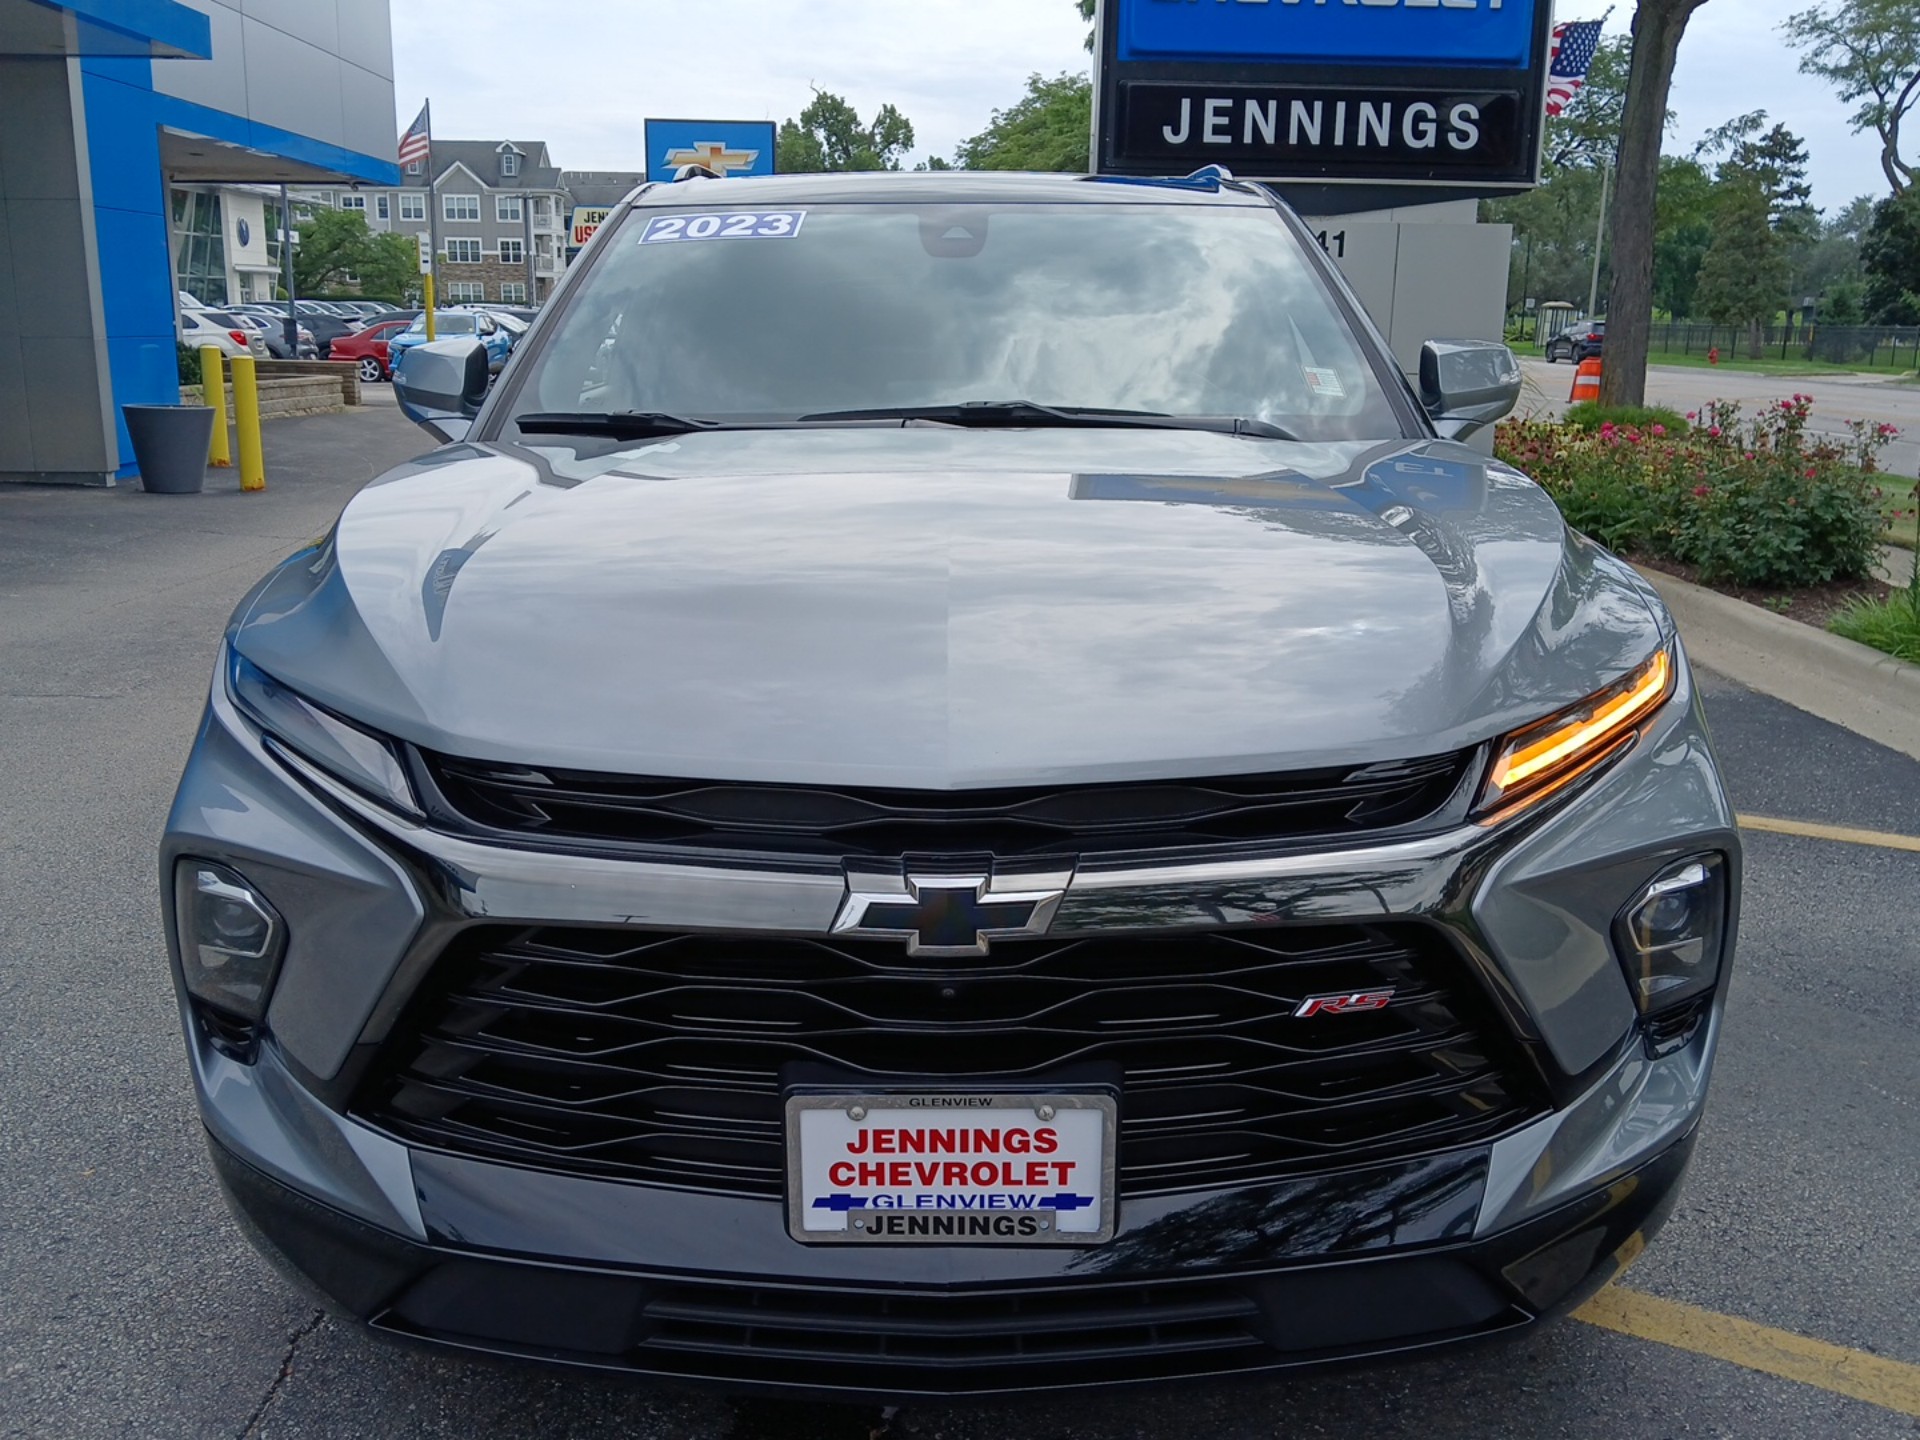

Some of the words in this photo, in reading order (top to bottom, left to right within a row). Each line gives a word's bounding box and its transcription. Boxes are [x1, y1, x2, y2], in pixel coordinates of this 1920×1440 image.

[1162, 98, 1480, 150] JENNINGS
[583, 211, 609, 223] JEN
[648, 214, 793, 240] 2023
[1294, 990, 1396, 1017] RS
[909, 1098, 993, 1107] GLENVIEW
[846, 1128, 1058, 1154] JENNINGS
[828, 1161, 1076, 1187] CHEVROLET
[871, 1194, 1037, 1209] GLENVIEW
[866, 1215, 1037, 1235] JENNINGS
